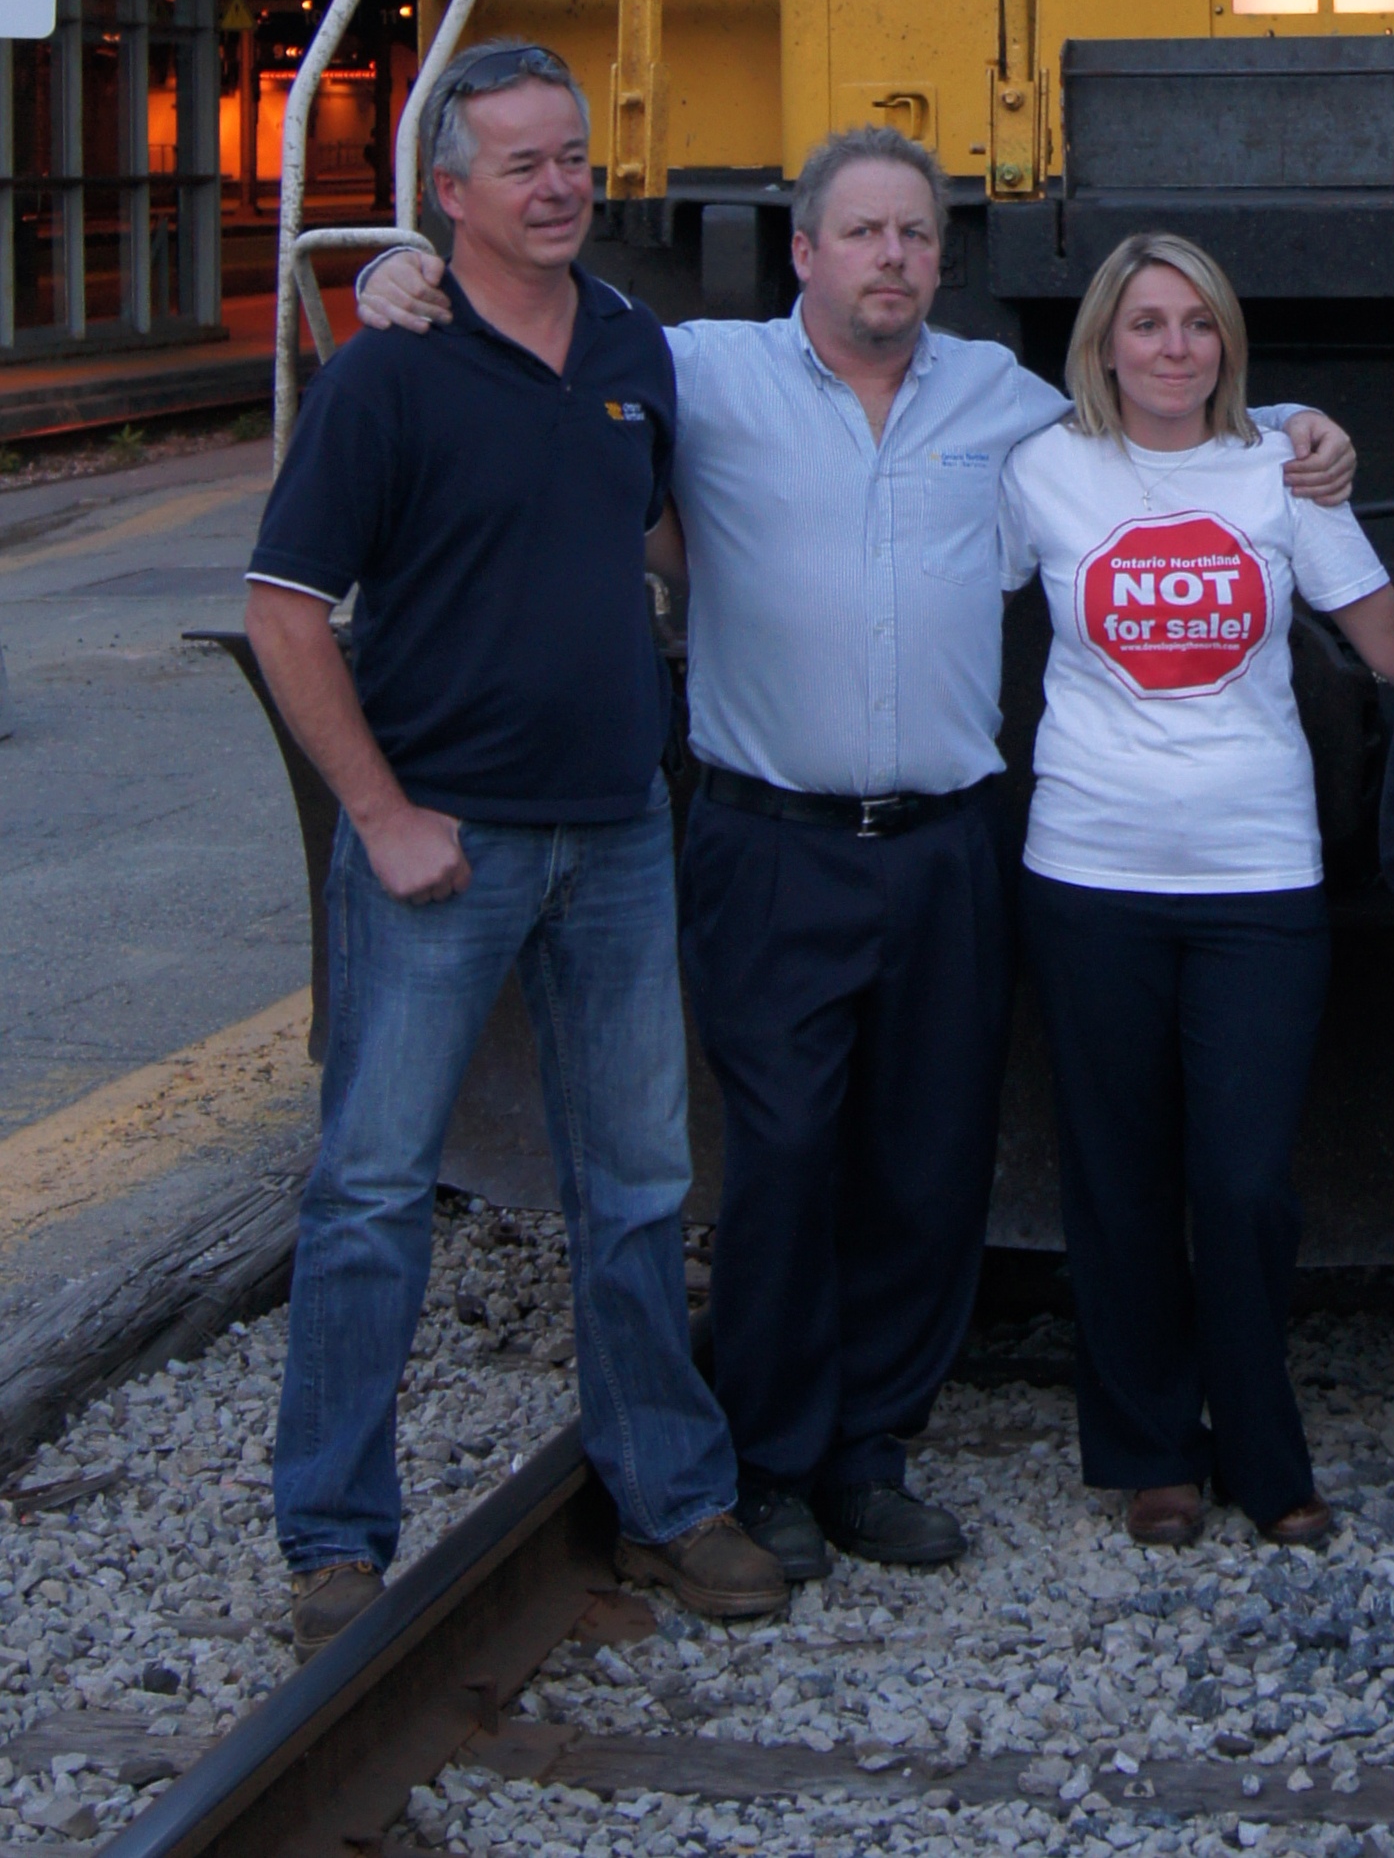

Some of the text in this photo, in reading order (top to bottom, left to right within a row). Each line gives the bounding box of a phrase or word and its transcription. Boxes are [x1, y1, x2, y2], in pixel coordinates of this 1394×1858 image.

[1110, 553, 1241, 569] Ontario Northland
[1113, 569, 1240, 607] NOT
[1103, 612, 1252, 642] for sale!
